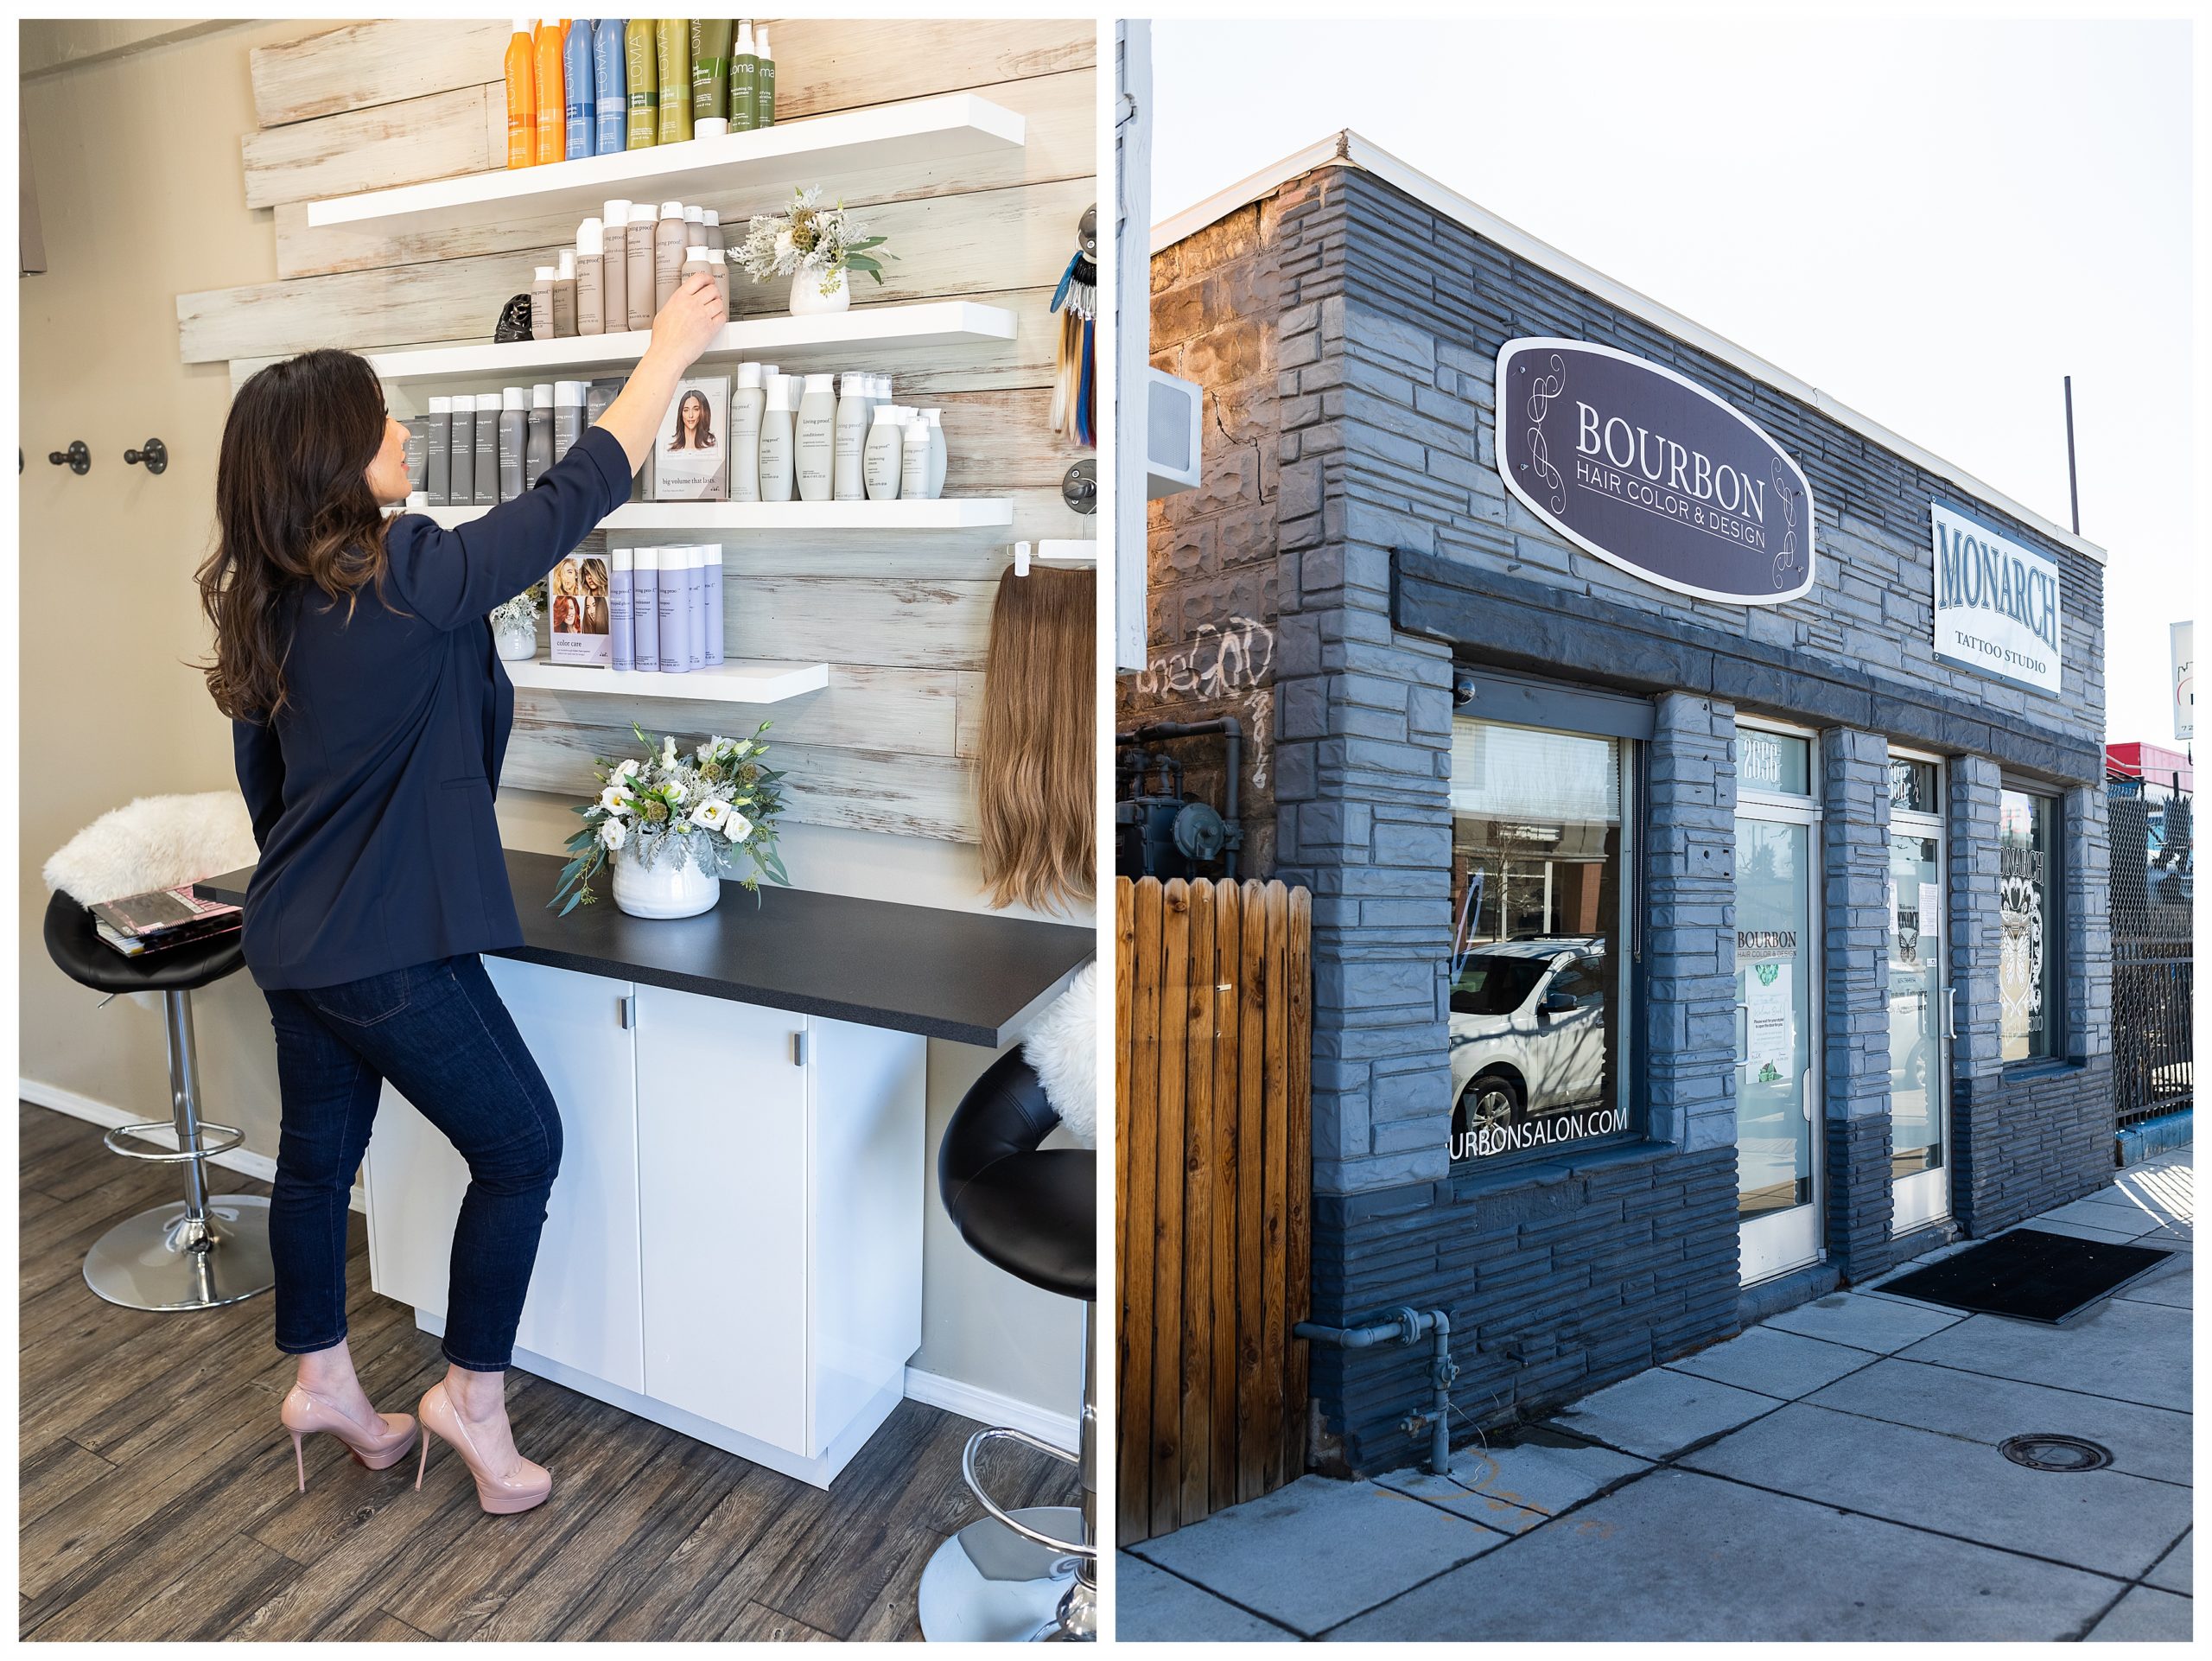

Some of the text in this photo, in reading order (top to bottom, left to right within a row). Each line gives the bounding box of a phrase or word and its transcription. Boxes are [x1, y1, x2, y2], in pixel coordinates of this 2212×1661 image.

[595, 41, 607, 93] LOMA
[629, 35, 643, 87] LOMA
[657, 28, 669, 84] LOMA
[662, 478, 671, 487] big
[691, 476, 702, 485] that
[1575, 400, 1765, 524] BOURBON
[1576, 461, 1765, 550] HAIR COLOR & DESIGN
[1936, 520, 2059, 656] MONARCH
[1955, 630, 2047, 674] TATTOO STUDIO
[1744, 738, 1778, 783] 2656
[1888, 765, 1906, 801] 656
[2000, 847, 2044, 887] ONARCH
[1737, 931, 1797, 948] BOURBON
[1448, 1107, 1629, 1161] URBONSALON.COM
